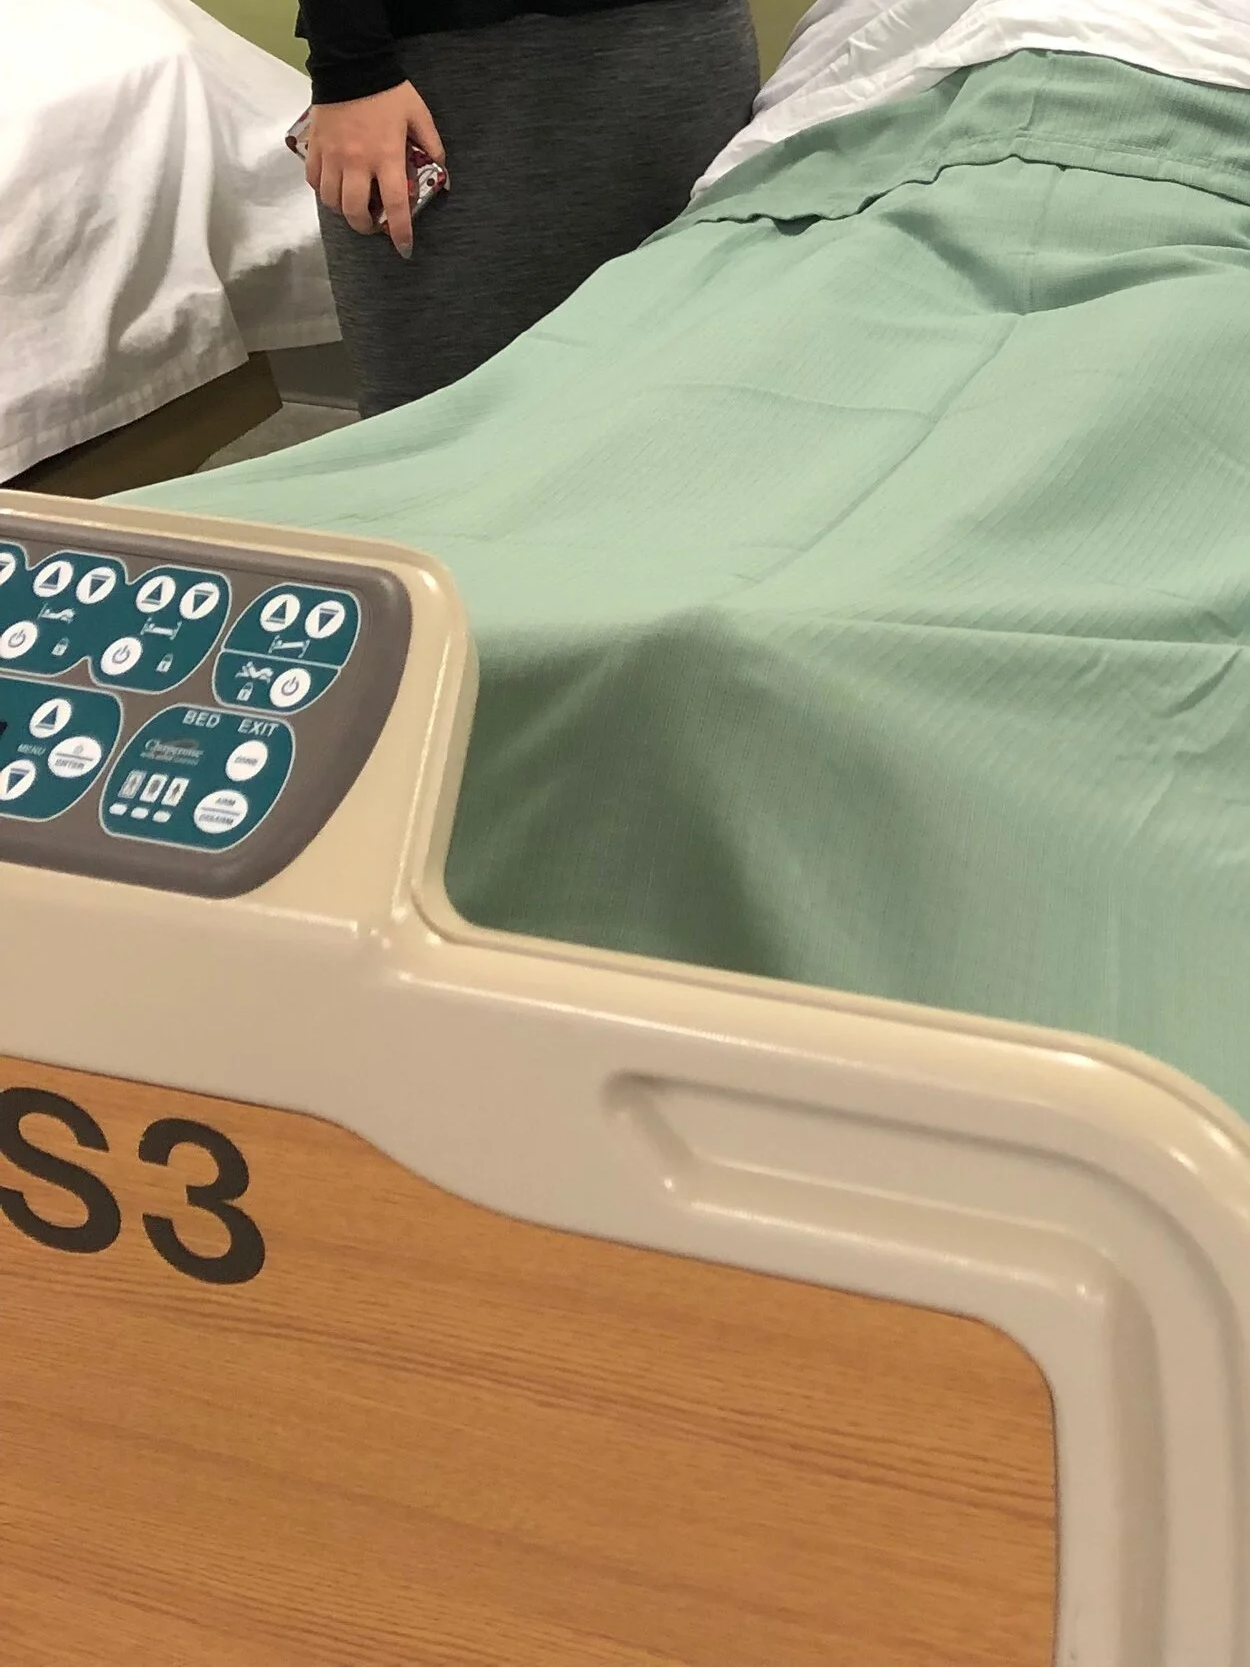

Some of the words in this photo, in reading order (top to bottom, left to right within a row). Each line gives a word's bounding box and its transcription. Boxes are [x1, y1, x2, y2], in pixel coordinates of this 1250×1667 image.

[183, 710, 221, 729] BED
[237, 718, 279, 737] EXIT
[0, 1086, 266, 1285] S3
